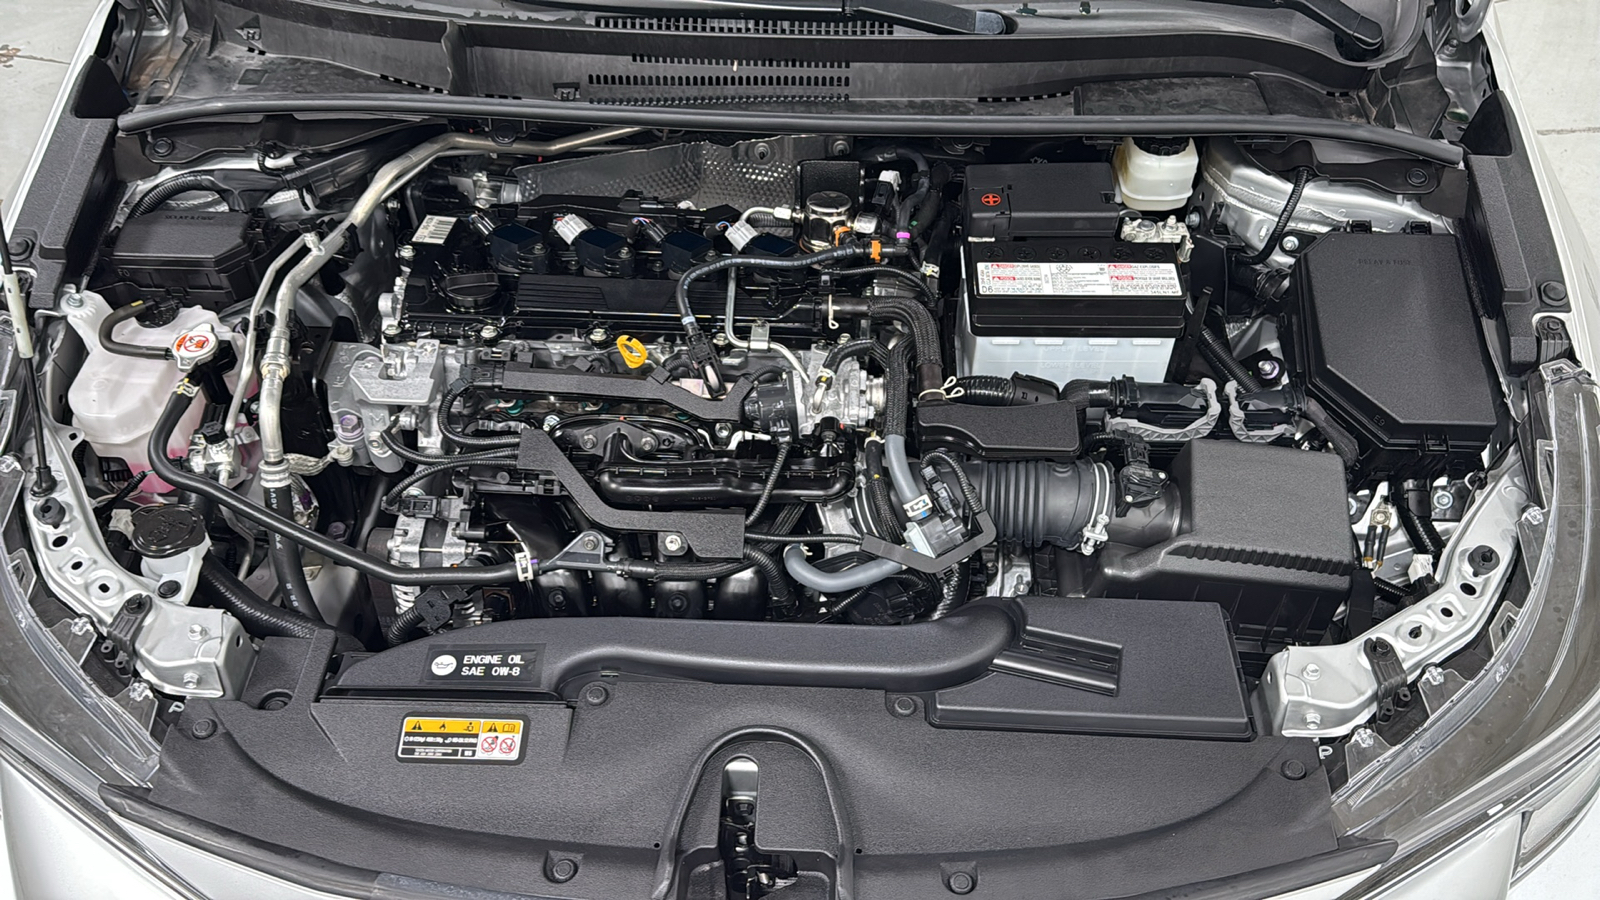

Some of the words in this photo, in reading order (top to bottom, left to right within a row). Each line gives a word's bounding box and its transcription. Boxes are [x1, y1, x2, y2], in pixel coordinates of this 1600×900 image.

[463, 655, 503, 665] ENGINE
[507, 655, 525, 664] OIL
[461, 667, 485, 676] SAE
[491, 667, 520, 676] 0W-8
